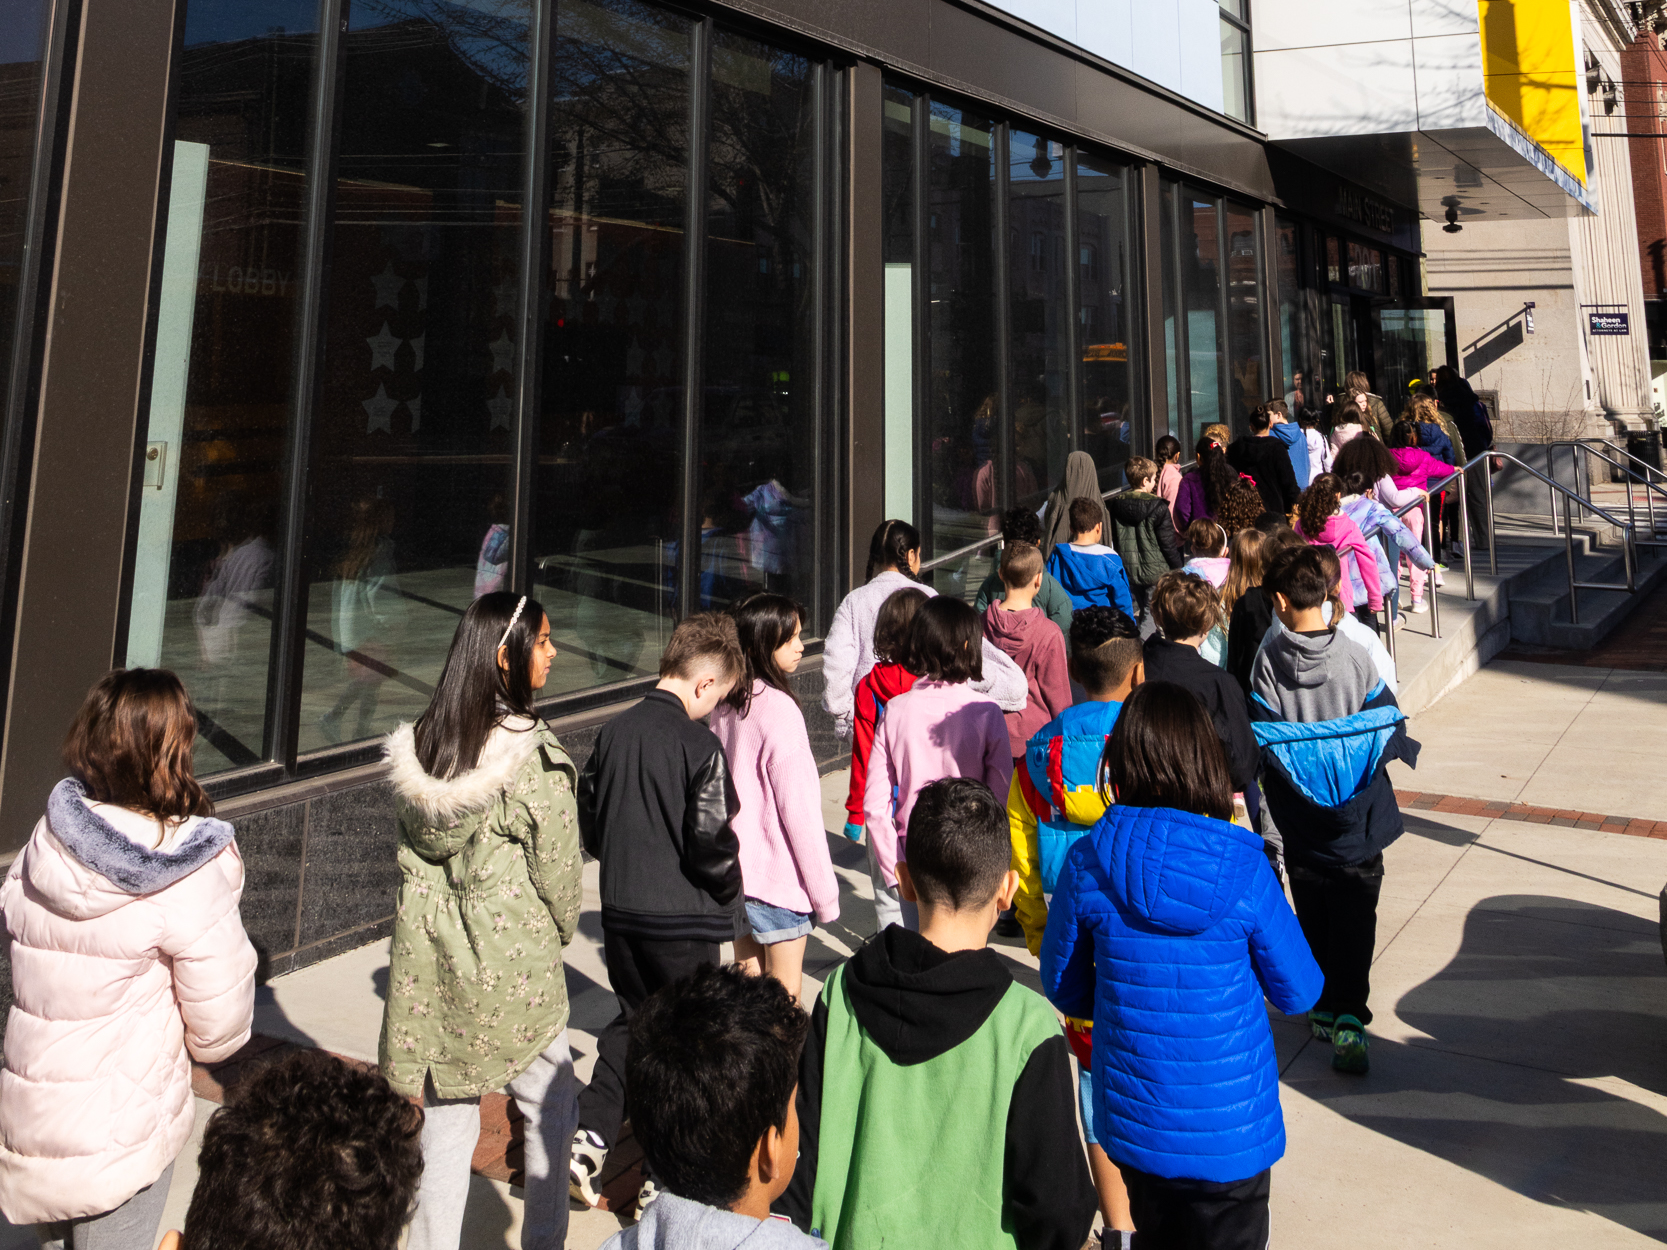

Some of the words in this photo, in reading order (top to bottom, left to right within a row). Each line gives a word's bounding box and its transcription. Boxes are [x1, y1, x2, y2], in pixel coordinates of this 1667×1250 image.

[1339, 185, 1362, 222] MAIN
[1364, 196, 1395, 234] STREET
[212, 264, 292, 297] LOBBY
